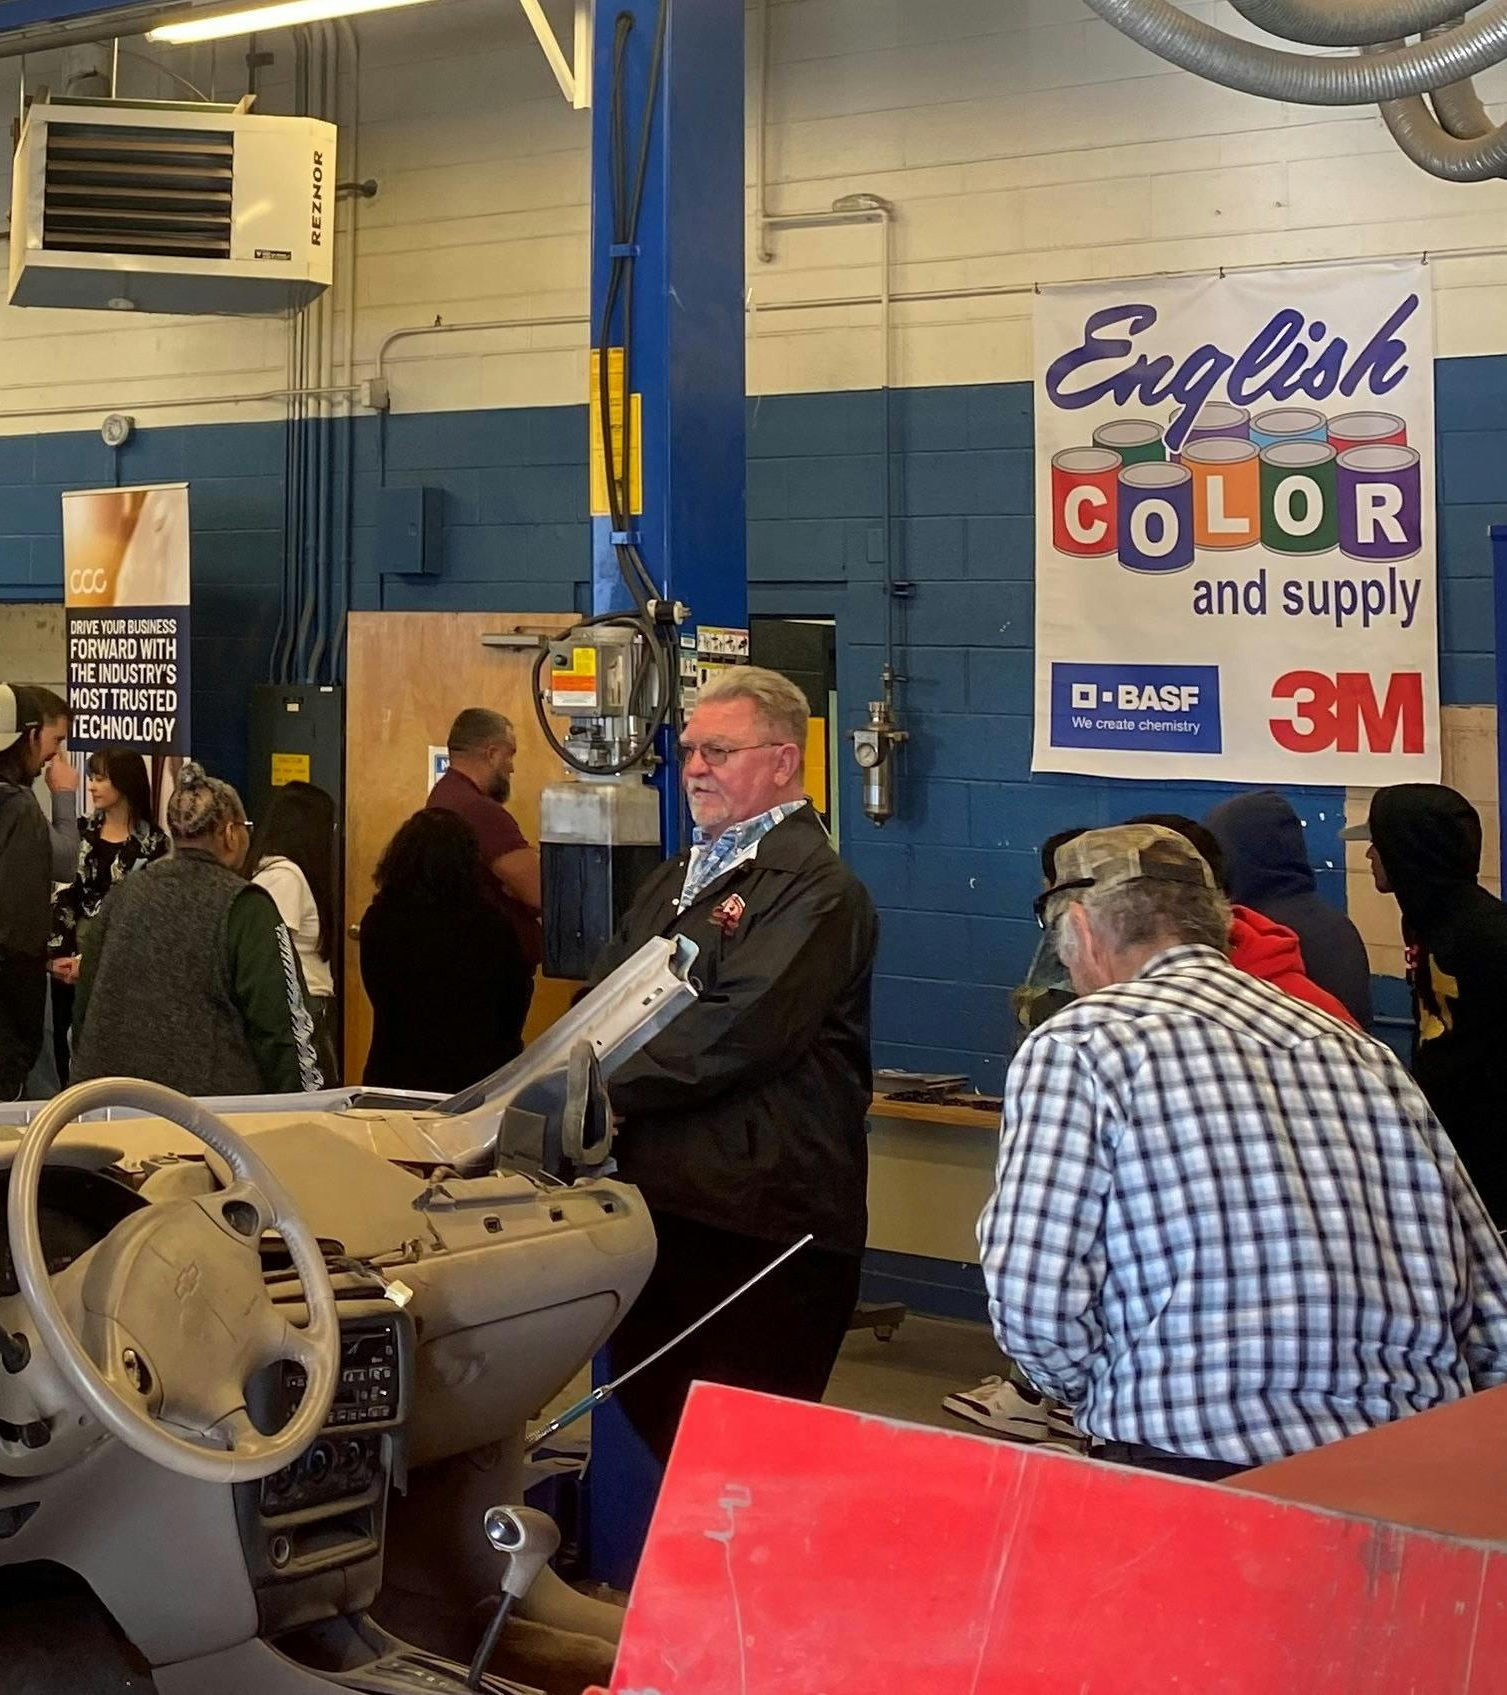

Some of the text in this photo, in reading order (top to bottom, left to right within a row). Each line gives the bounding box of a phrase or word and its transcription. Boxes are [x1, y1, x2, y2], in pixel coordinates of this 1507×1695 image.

[311, 150, 323, 247] REZNOR
[1046, 293, 1420, 452] English
[1063, 474, 1408, 557] COLOR
[70, 568, 107, 594] CCC
[1193, 566, 1422, 628] and supply
[70, 618, 177, 635] DRIVE YOUR BUSINESS
[70, 637, 177, 660] FORWARD WITH
[70, 663, 177, 685] THE INDUSTRY'S
[70, 687, 178, 712] MOST TRUSTED
[1117, 684, 1199, 712] BASF
[1268, 670, 1425, 754] 3M
[71, 714, 176, 743] TECHNOLOGY
[1071, 715, 1201, 736] We create chemistry
